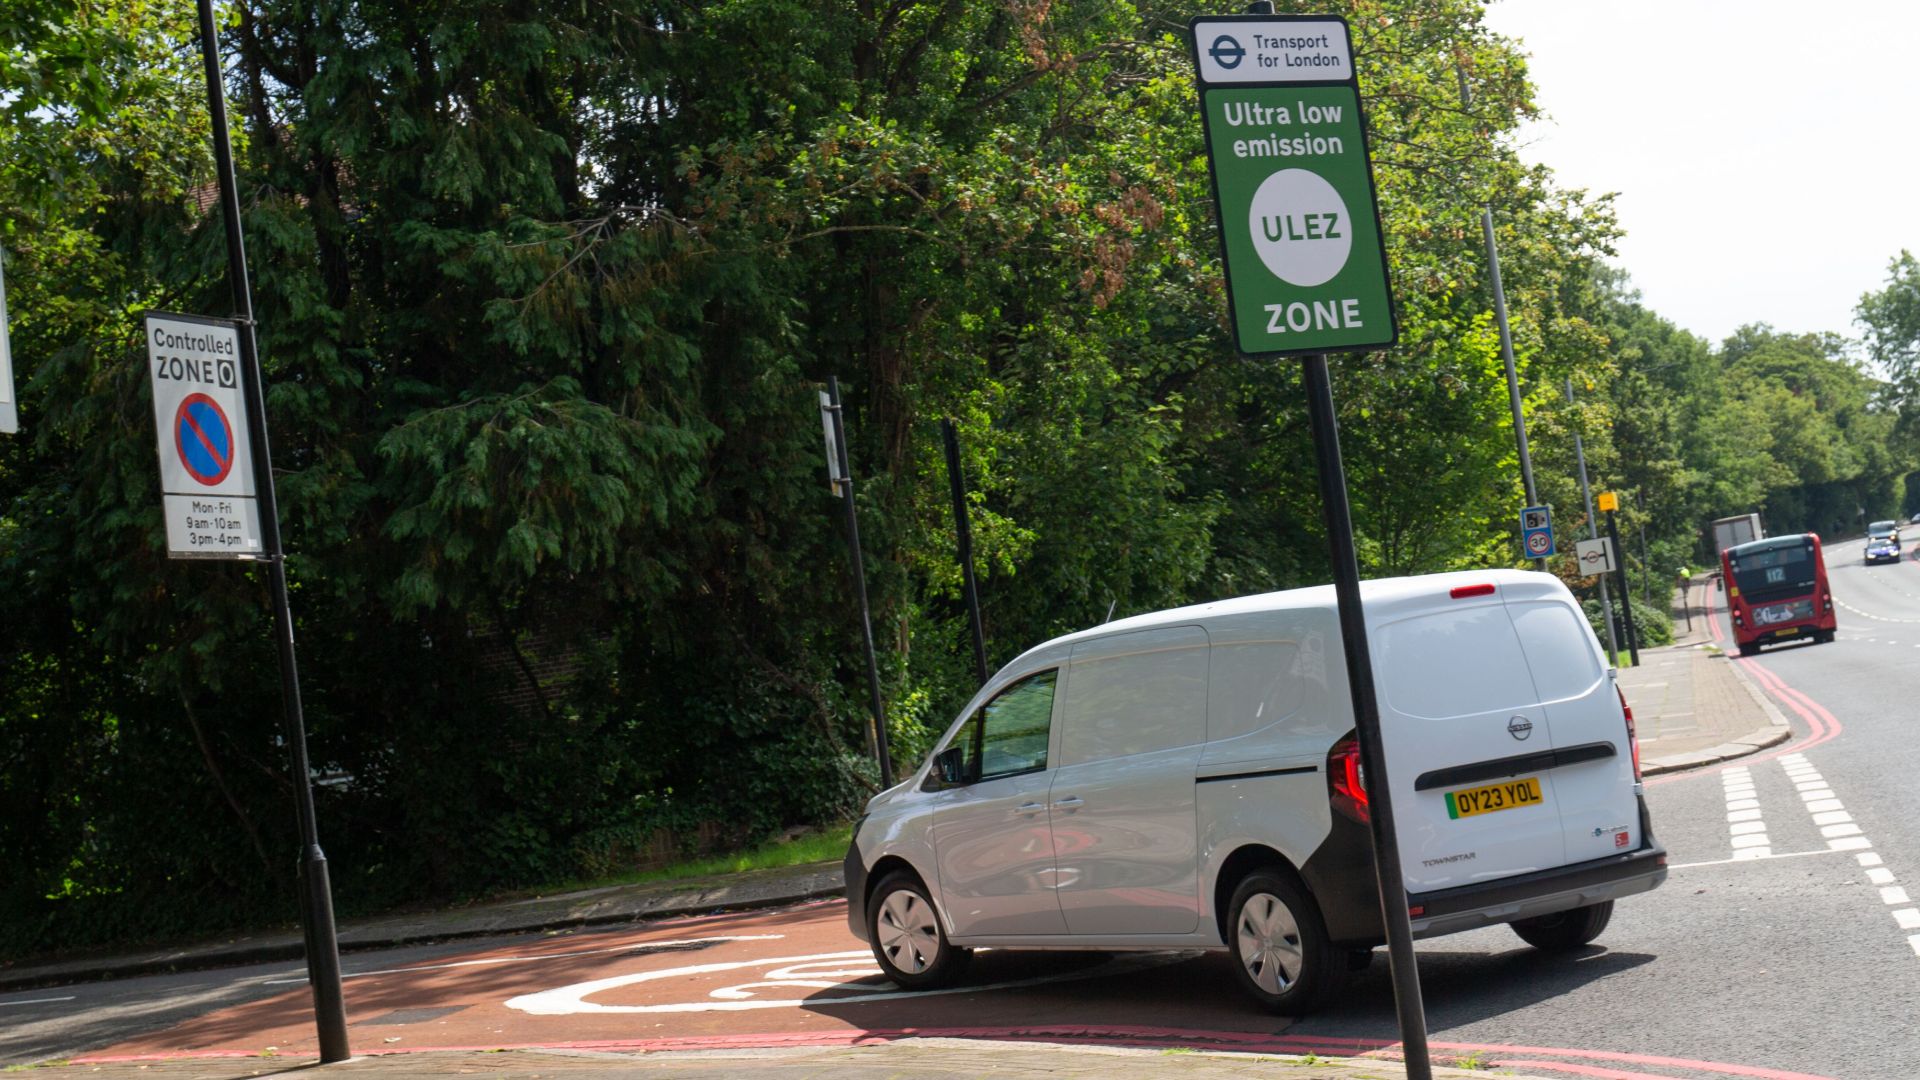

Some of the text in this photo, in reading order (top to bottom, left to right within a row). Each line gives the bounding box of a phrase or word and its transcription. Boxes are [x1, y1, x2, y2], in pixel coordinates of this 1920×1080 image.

[1253, 34, 1329, 51] Transport
[1256, 53, 1341, 68] for London
[1223, 100, 1343, 127] Ultra low
[1233, 132, 1344, 158] emission
[1261, 212, 1342, 243] ULEZ
[1263, 298, 1364, 335] ZONE
[153, 327, 234, 356] Controlled
[156, 355, 215, 385] ZONE
[1531, 536, 1547, 548] 30
[1458, 781, 1540, 814] OY23 YOL
[1422, 852, 1477, 868] TOWNSTAR
